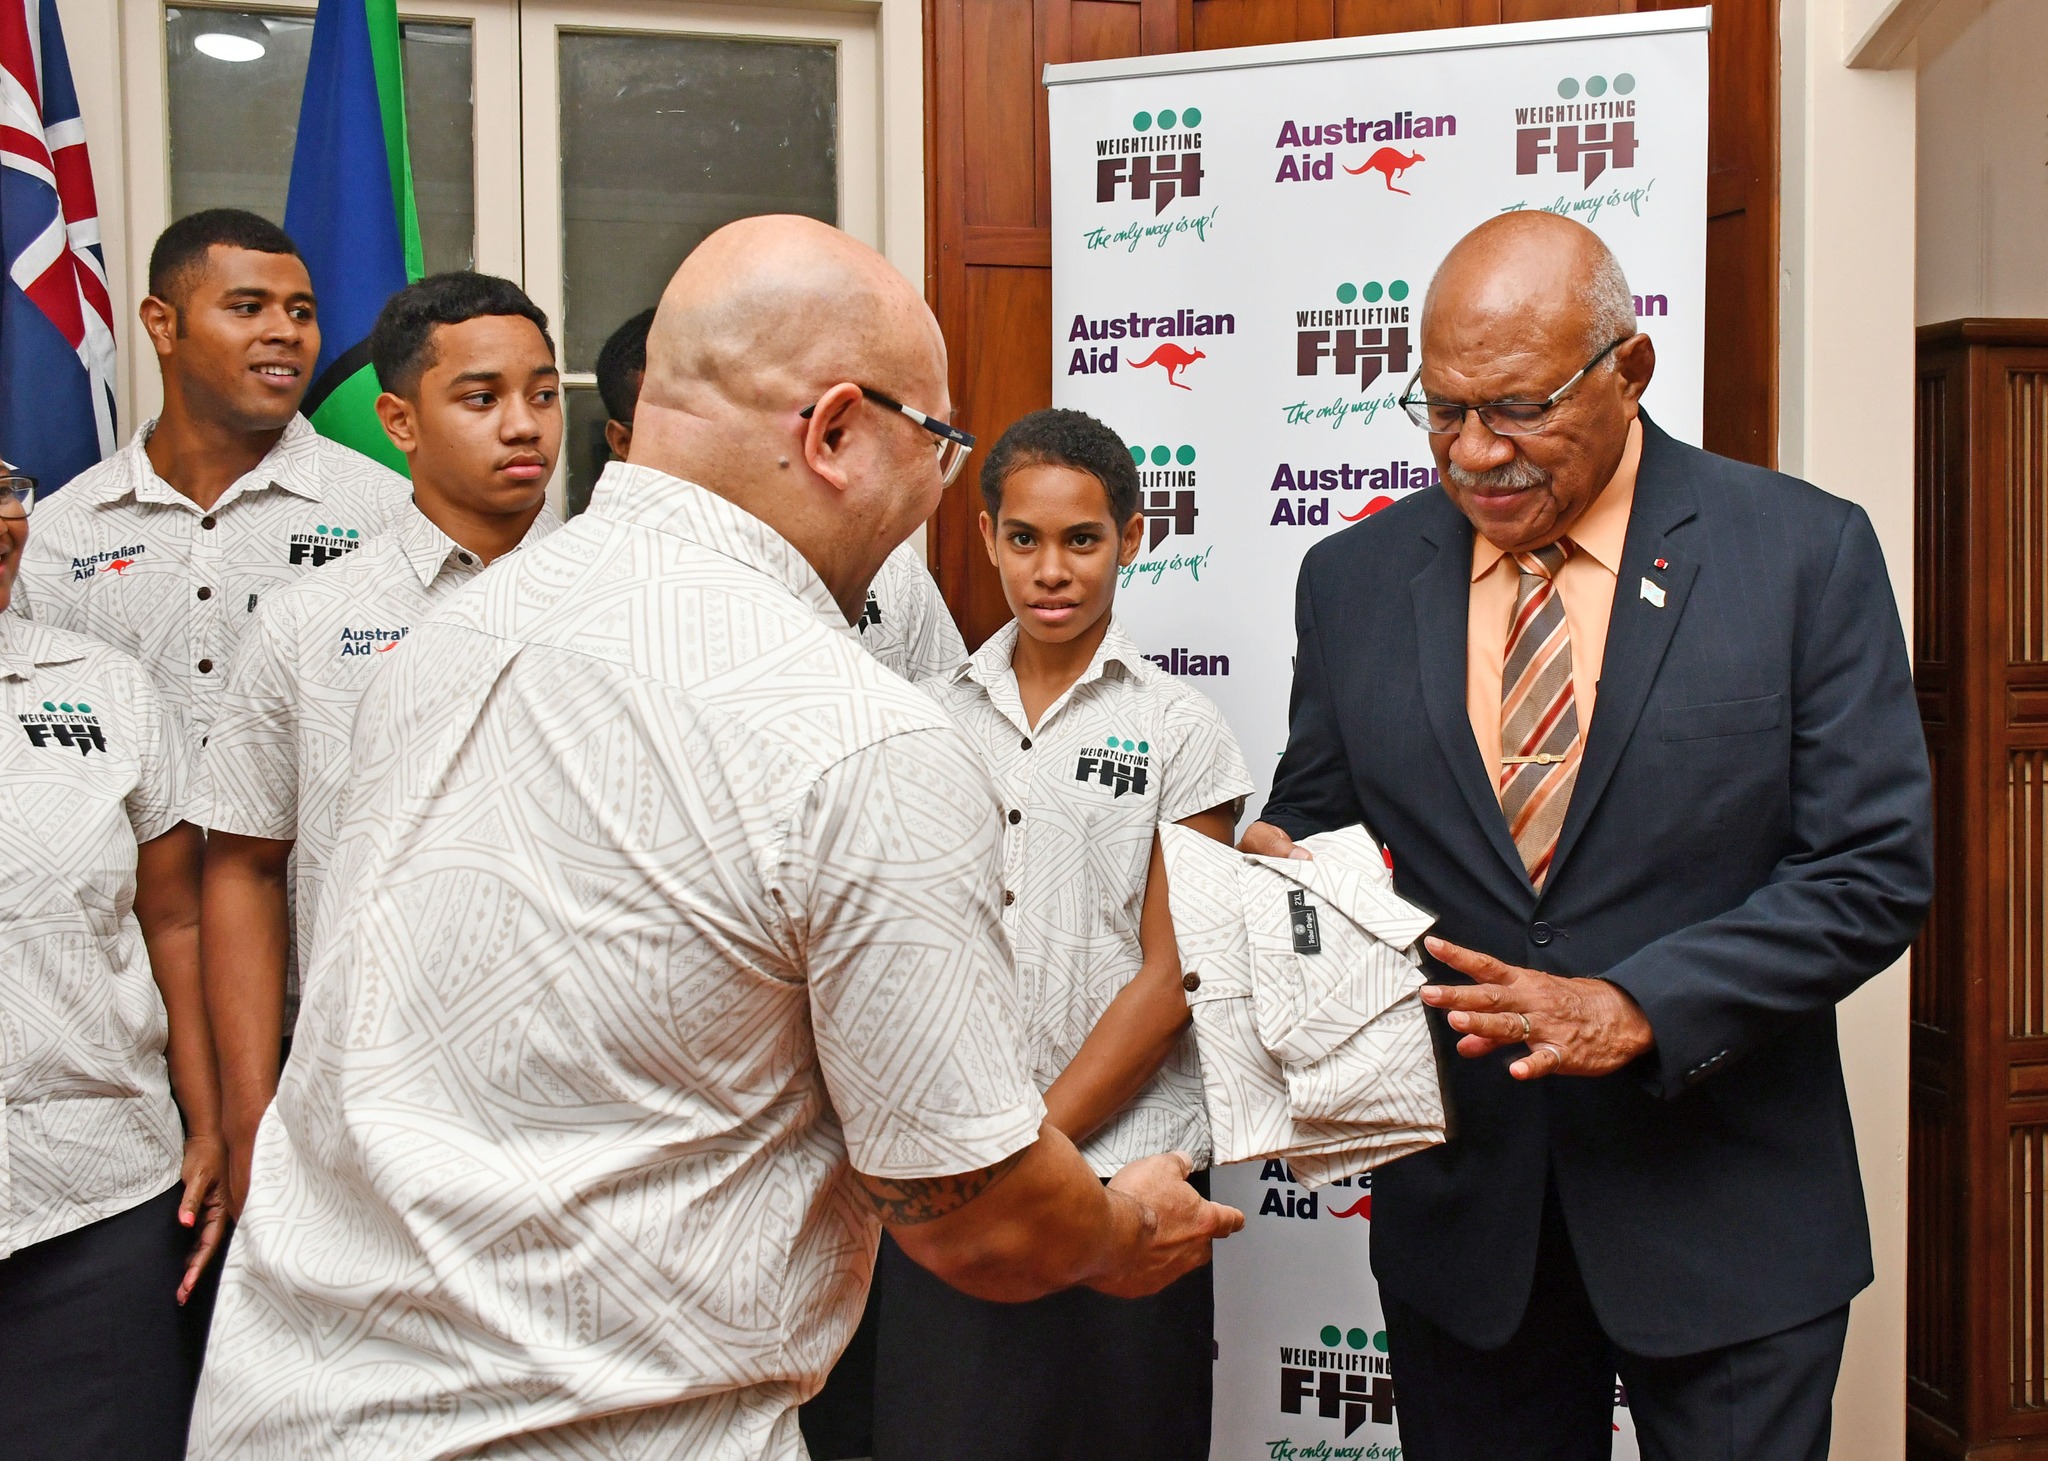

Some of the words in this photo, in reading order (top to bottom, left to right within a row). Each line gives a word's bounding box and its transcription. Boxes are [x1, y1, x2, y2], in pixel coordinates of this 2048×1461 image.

[1515, 100, 1636, 125] WEIGHTLIFTING
[1275, 111, 1457, 148] Australian
[1096, 132, 1203, 157] WEIGHTLIFTING
[1275, 152, 1334, 183] Aid
[1573, 195, 1605, 223] way
[1607, 188, 1621, 206] is
[1623, 177, 1656, 217] up!
[1083, 226, 1110, 251] The
[1113, 221, 1143, 254] only
[1144, 223, 1175, 248] way
[1176, 215, 1189, 233] is
[1187, 205, 1219, 243] up!
[1068, 309, 1235, 342] Australian
[1297, 306, 1410, 328] WEIGHTLIFTING
[1068, 346, 1119, 376] Aid
[1282, 400, 1315, 425] The
[1316, 397, 1349, 430] only
[1351, 398, 1380, 425] way
[1382, 392, 1396, 409] is
[1138, 470, 1196, 488] LIFTING
[1270, 497, 1329, 526] Aid
[290, 534, 360, 549] WEIGHTLIFTING
[71, 544, 146, 570] Australian
[1139, 559, 1168, 585] way
[1169, 553, 1183, 570] is
[1184, 545, 1213, 582] up!
[73, 565, 95, 582] Aid
[341, 641, 371, 656] Aid
[1140, 648, 1230, 676] alian
[18, 713, 100, 725] WEIGHTLIFTING
[1080, 747, 1149, 767] WEIGHTLIFTING
[1293, 892, 1303, 906] 2XL
[1259, 1188, 1319, 1220] Aid
[1266, 1437, 1298, 1461] The
[1300, 1440, 1332, 1461] only
[1334, 1446, 1365, 1461] way
[1366, 1442, 1380, 1459] is
